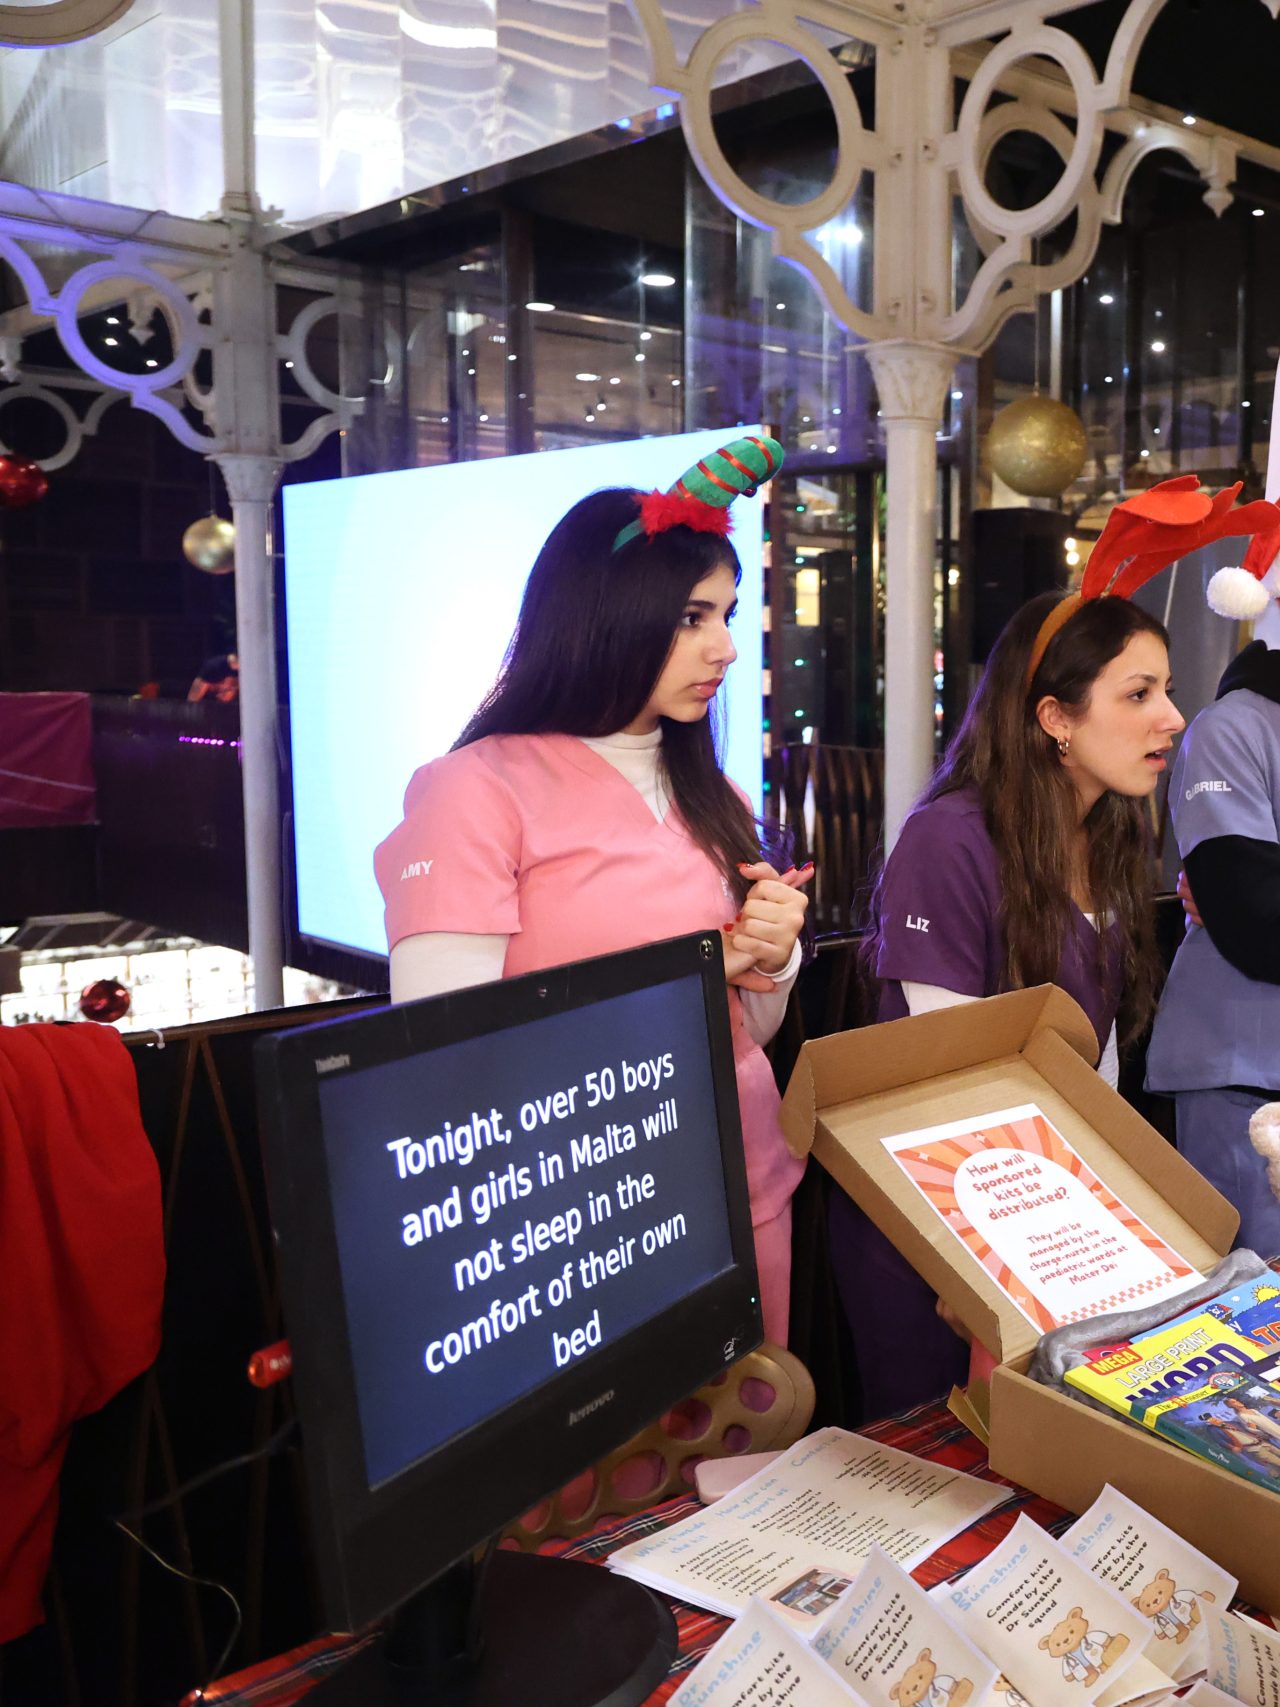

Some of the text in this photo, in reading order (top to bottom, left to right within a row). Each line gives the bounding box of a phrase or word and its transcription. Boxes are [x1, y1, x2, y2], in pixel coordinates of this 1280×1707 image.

[1185, 780, 1232, 801] GABRIEL
[400, 860, 434, 881] AMY
[906, 915, 931, 933] LIZ
[387, 1053, 675, 1179] Tonight, over 50 boys
[402, 1098, 678, 1247] and girls in Malta will
[966, 1153, 1026, 1177] How will
[972, 1163, 1042, 1194] sponsored
[988, 1186, 1070, 1220] distributed?
[993, 1182, 1042, 1201] kits be
[454, 1173, 656, 1291] not sleep in the
[1026, 1222, 1082, 1245] They will be
[1028, 1229, 1100, 1259] managed by the
[1029, 1236, 1118, 1272] charge-nurse in the
[1039, 1245, 1128, 1285] paediatric wards at
[424, 1214, 687, 1374] comfort of their own
[1069, 1263, 1118, 1286] Mater Dei
[552, 1309, 602, 1367] bed
[1092, 1350, 1137, 1375] MEGA
[1115, 1328, 1214, 1389] LARGE PRINT
[1073, 1513, 1112, 1557] shine
[1091, 1524, 1133, 1572] mfort kits
[1112, 1552, 1125, 1564] by
[1125, 1534, 1139, 1550] the
[958, 1543, 1028, 1612] Sunshine
[1111, 1541, 1147, 1582] Sunshine
[1118, 1563, 1144, 1591] squad
[986, 1558, 1048, 1618] Comfort kits
[998, 1568, 1054, 1625] made by the
[1006, 1577, 1062, 1632] Dr Sunshine
[821, 1576, 882, 1660] Sunshine
[845, 1592, 900, 1666] Comfort kits
[1028, 1600, 1057, 1628] squad
[854, 1604, 906, 1673] made by the
[861, 1614, 913, 1681] Dr Sunshine
[881, 1640, 908, 1675] squad
[1265, 1645, 1274, 1661] the
[731, 1651, 784, 1707] mfort kits
[758, 1664, 792, 1702] by the
[1257, 1656, 1266, 1706] Comfort
[1269, 1665, 1279, 1678] by
